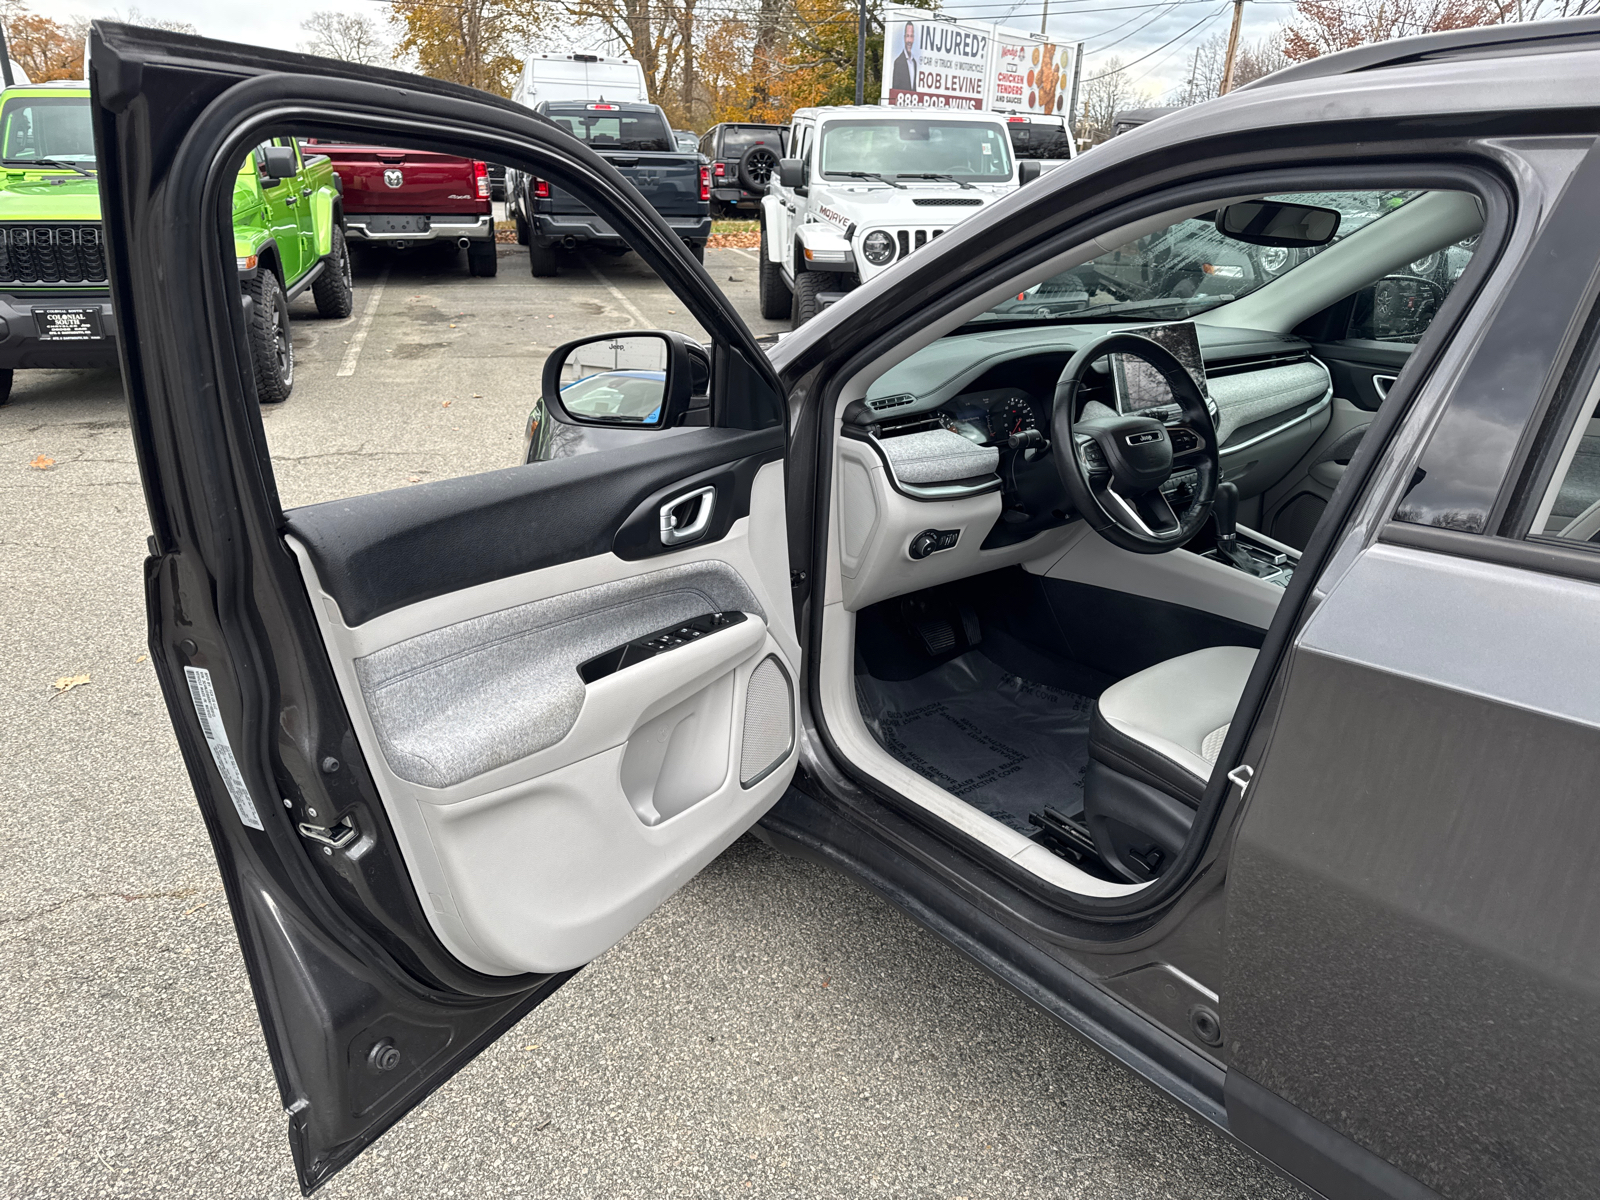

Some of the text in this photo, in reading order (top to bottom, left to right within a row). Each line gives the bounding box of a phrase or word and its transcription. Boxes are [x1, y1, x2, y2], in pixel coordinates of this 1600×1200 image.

[919, 25, 987, 59] INJURED?
[918, 71, 982, 94] ROB LEVINE
[996, 83, 1023, 96] TENDERS
[997, 72, 1024, 85] CHICKEN
[819, 204, 851, 227] MOJAVE
[1035, 689, 1059, 704] COVER
[940, 712, 1015, 760] DEALER MUST REMOVE
[960, 717, 1024, 757] PROTECTIVE COVER
[907, 751, 928, 765] MUST
[927, 765, 958, 784] REMOVE
[911, 762, 935, 778] COVER
[946, 778, 976, 792] DEALER
[976, 768, 999, 780] MUST
[954, 765, 1023, 796] PROTECTIVE COVER
